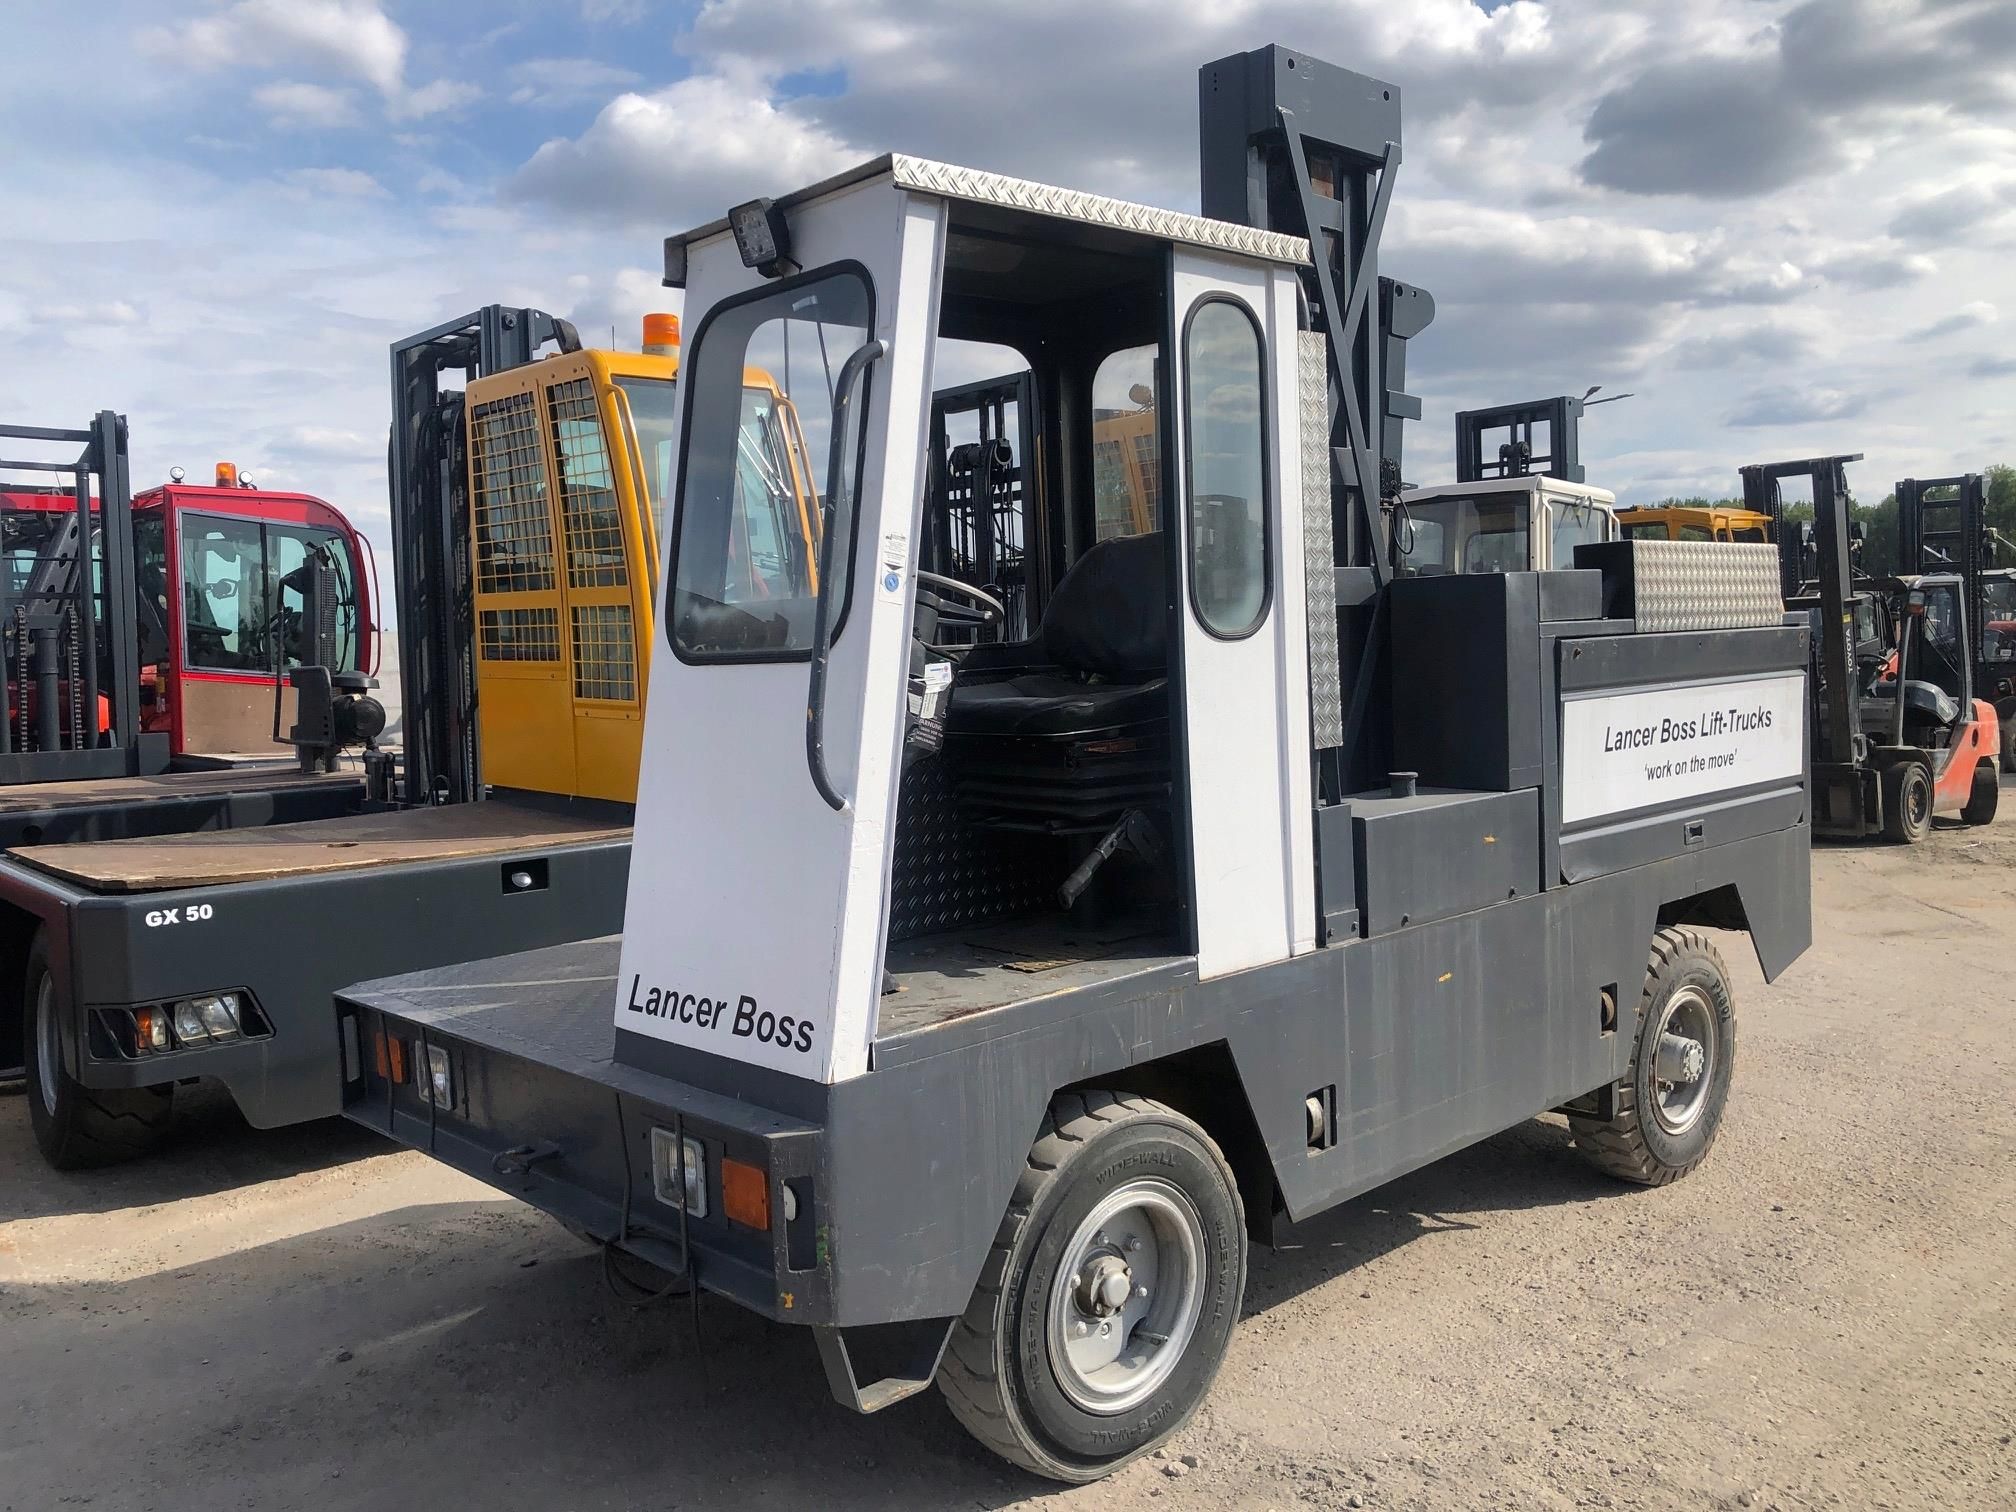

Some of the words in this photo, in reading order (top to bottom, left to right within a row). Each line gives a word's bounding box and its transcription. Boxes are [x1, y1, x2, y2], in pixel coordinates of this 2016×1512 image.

[1845, 628, 1853, 675] TOYOTA
[1604, 724, 1658, 752] Lancer
[1660, 718, 1696, 743] Boss
[1700, 706, 1772, 738] Lift-Trucks
[1674, 762, 1687, 774] on
[1690, 755, 1705, 772] the
[145, 908, 180, 927] GX
[186, 904, 213, 921] 50
[627, 973, 728, 1030] Lancer
[731, 995, 815, 1053] Boss
